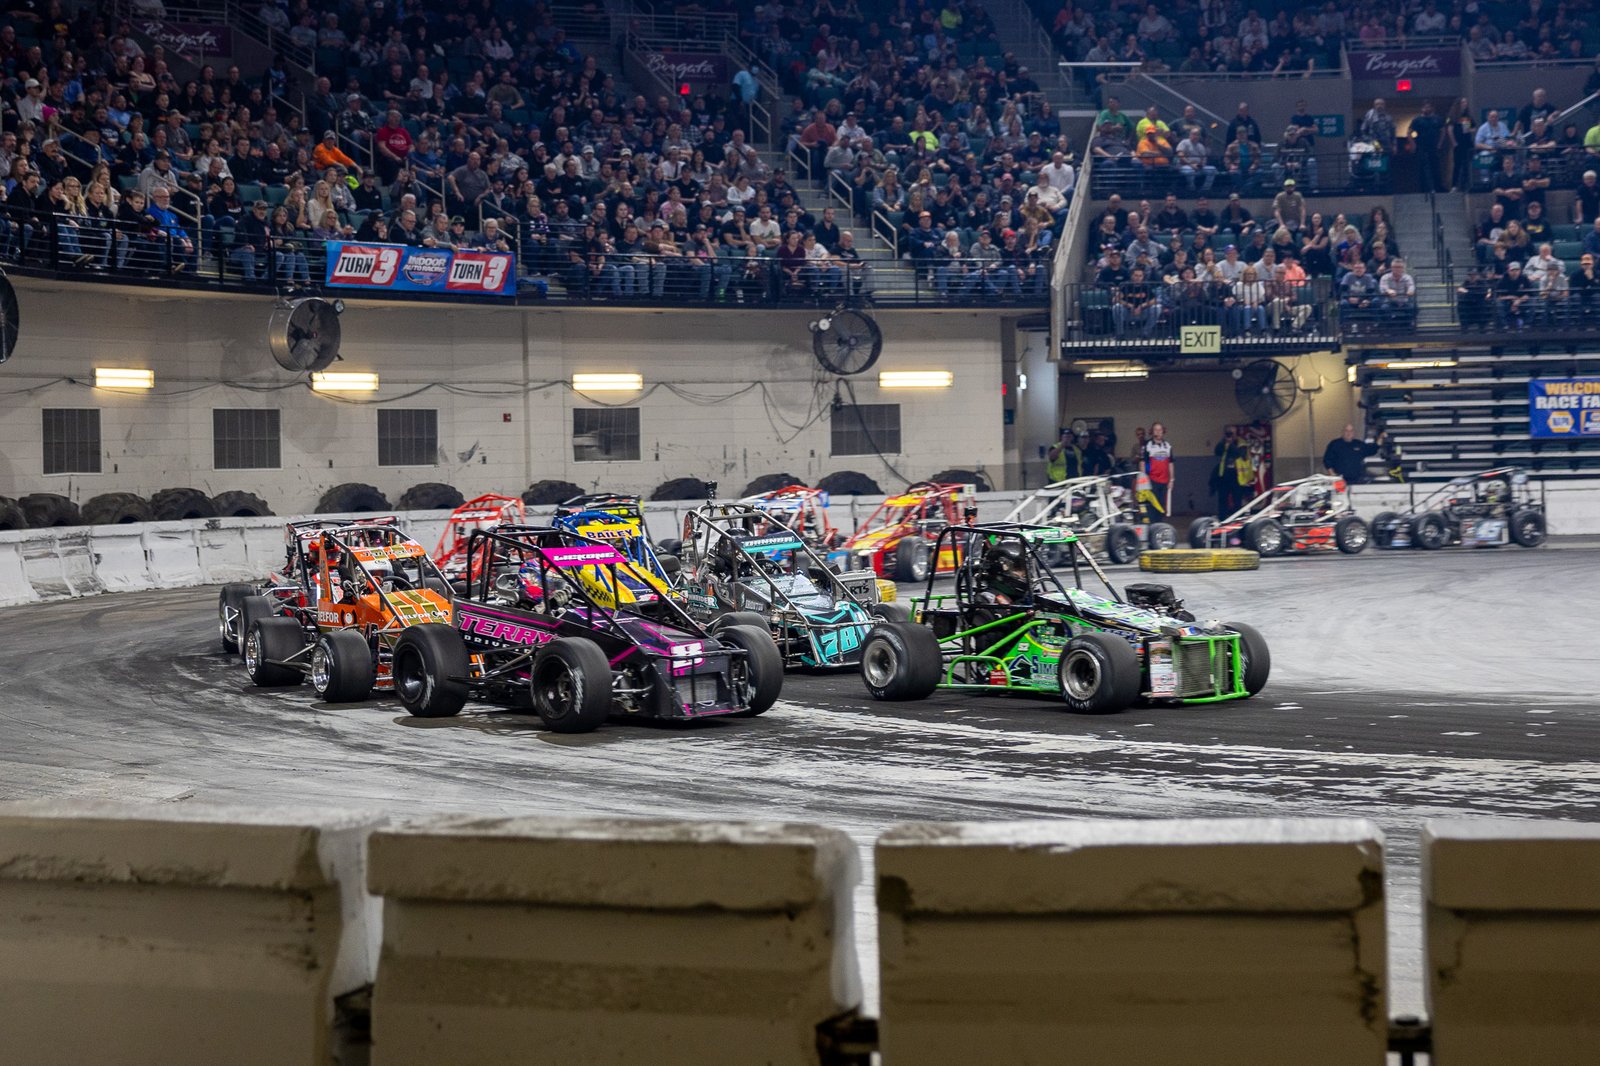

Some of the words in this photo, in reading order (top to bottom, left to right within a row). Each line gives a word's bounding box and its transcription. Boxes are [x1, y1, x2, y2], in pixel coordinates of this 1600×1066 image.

[1366, 53, 1438, 78] Borgata
[340, 256, 373, 274] TURN
[371, 249, 399, 284] 3
[408, 255, 447, 266] INDOOR
[453, 262, 484, 280] TURN
[482, 256, 508, 290] 3
[1184, 331, 1217, 347] EXIT
[1535, 396, 1580, 409] RACE
[586, 529, 633, 539] BAILEY
[820, 626, 860, 657] 78
